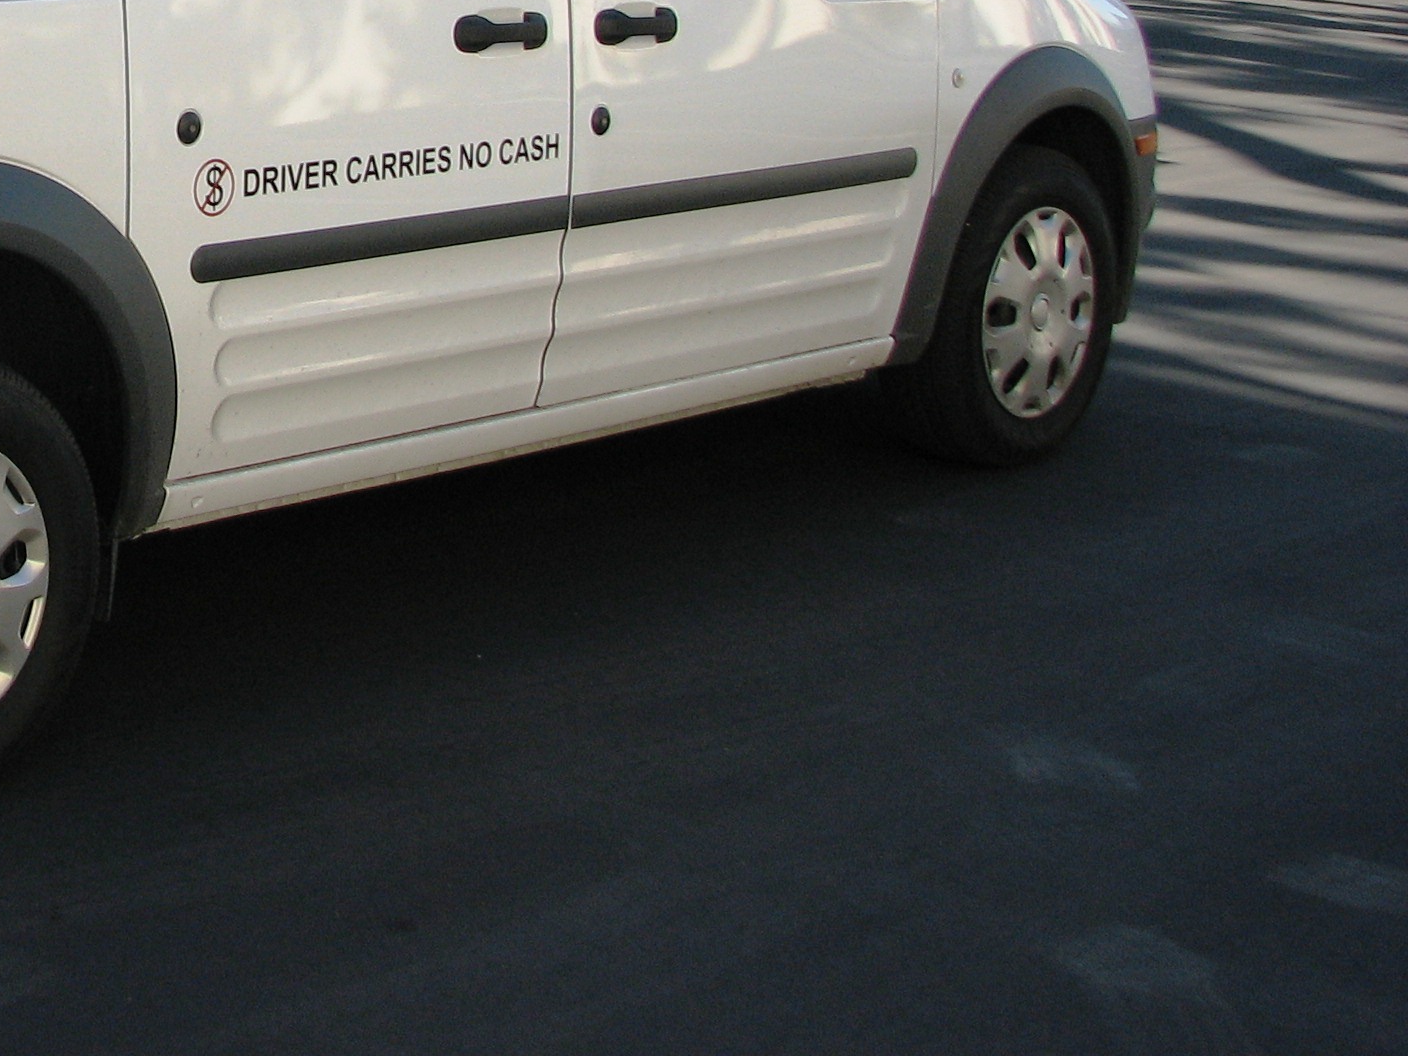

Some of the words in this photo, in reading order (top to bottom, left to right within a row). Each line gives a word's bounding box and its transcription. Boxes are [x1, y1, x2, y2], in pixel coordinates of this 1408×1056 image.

[243, 159, 339, 197] DRIVER
[346, 145, 452, 184] CARRIES
[459, 140, 493, 171] NO
[499, 133, 561, 166] CASH
